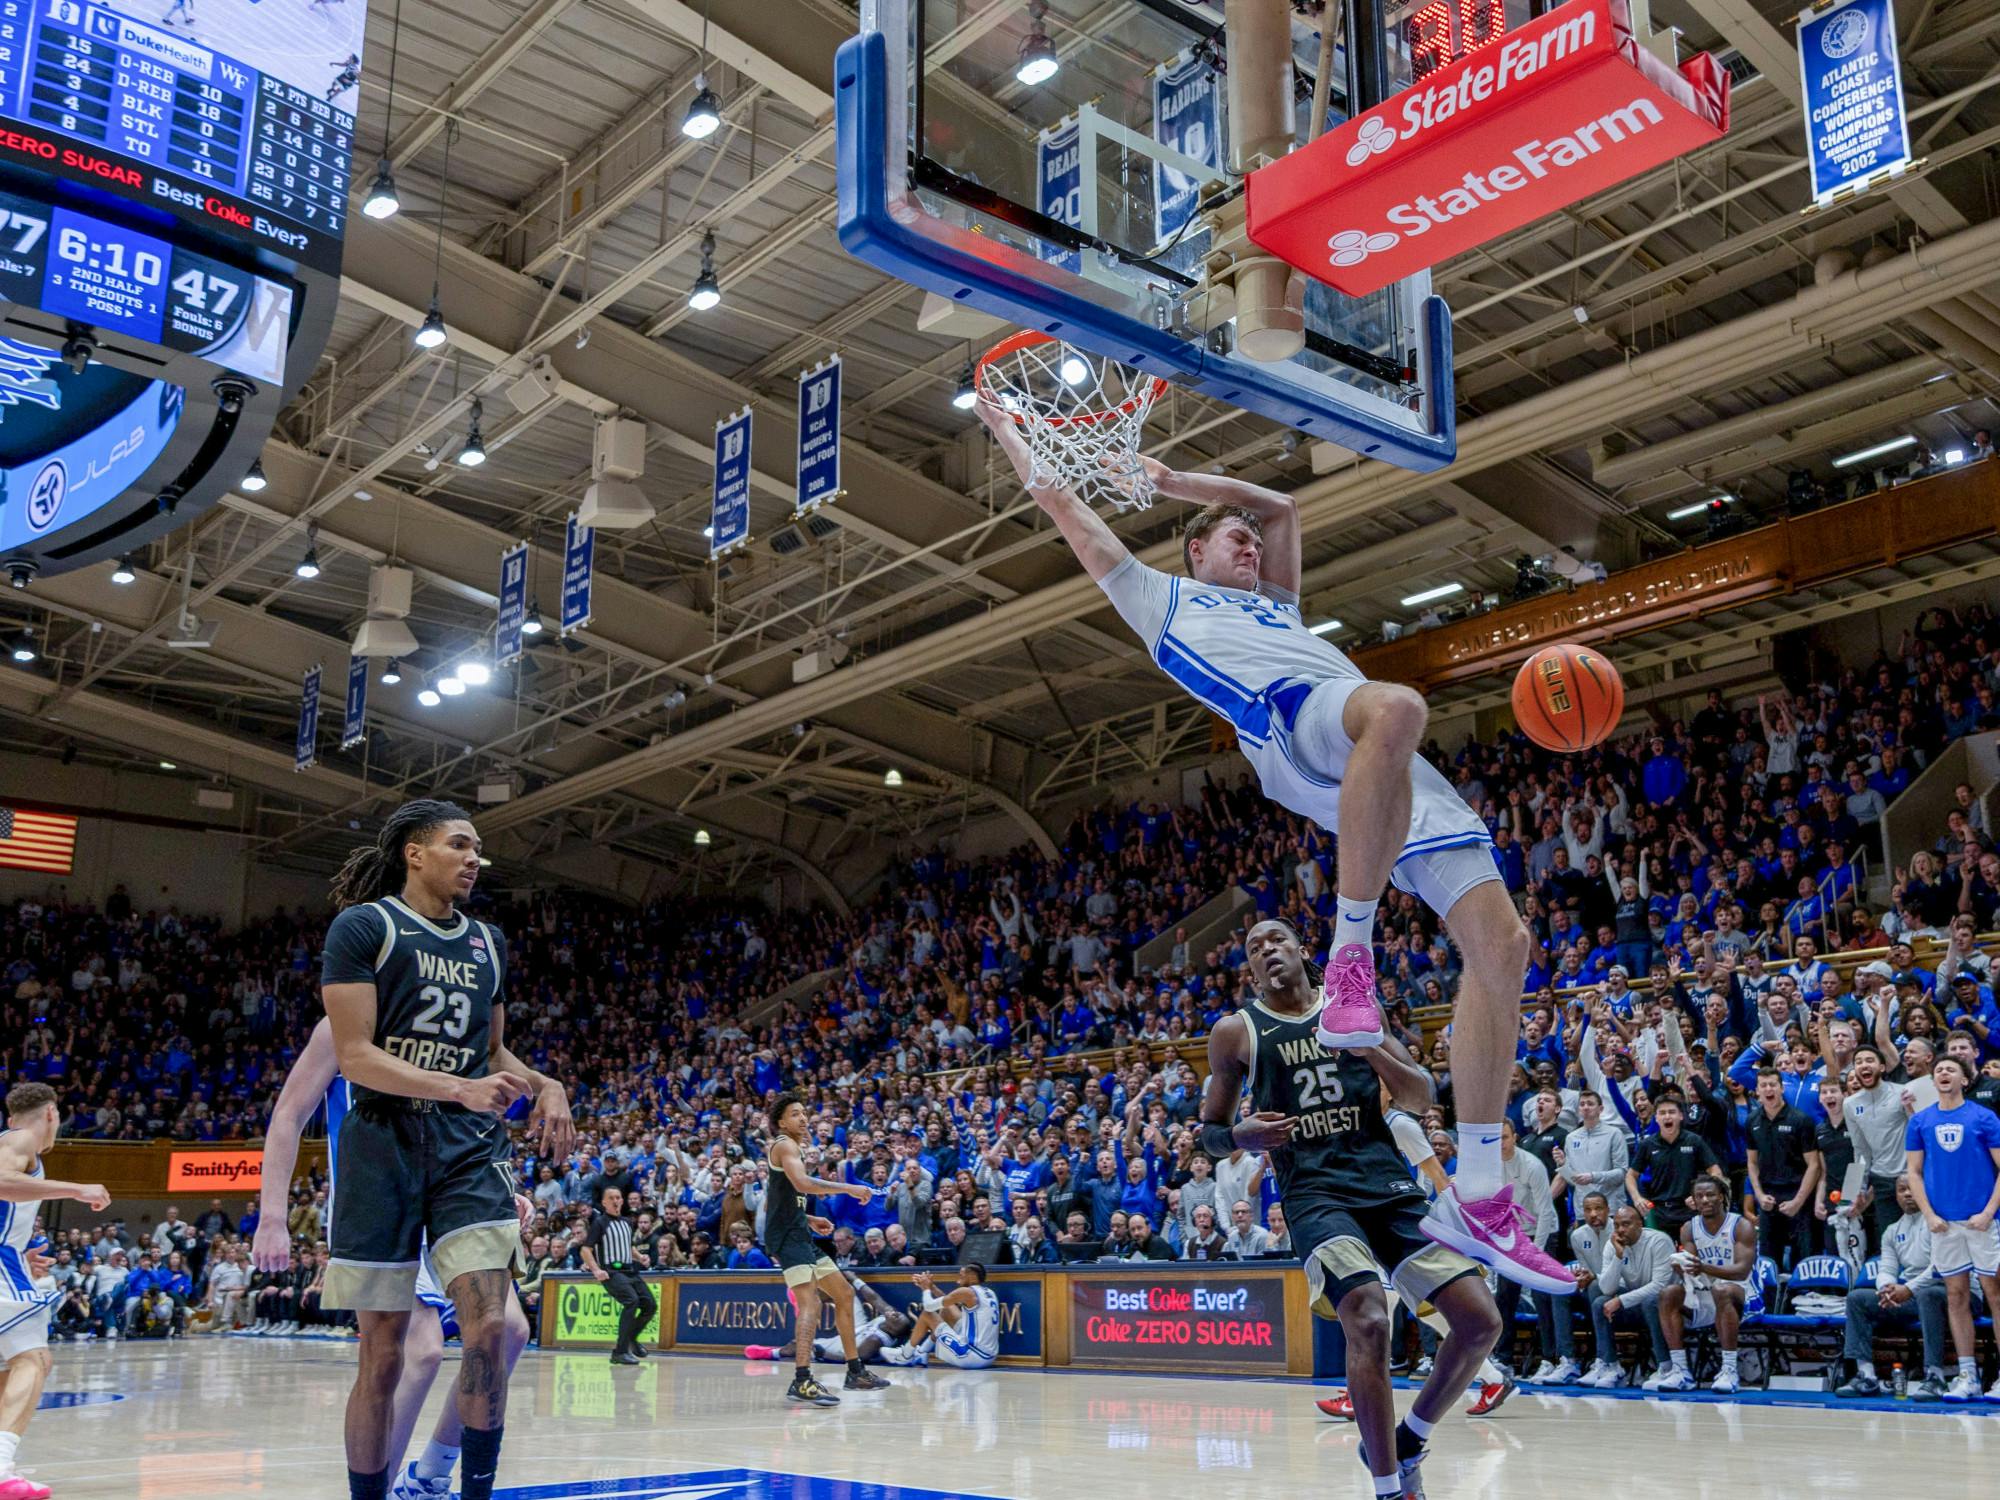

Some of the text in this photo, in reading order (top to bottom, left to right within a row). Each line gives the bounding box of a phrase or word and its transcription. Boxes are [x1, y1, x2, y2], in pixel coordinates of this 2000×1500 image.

[4, 2, 18, 17] 2
[1, 24, 14, 39] 2
[63, 53, 221, 121] 24 D-REB 18
[67, 35, 92, 54] 15
[199, 84, 222, 103] 10
[1821, 52, 1879, 89] ATLANTIC
[1831, 70, 1871, 98] COAST
[67, 74, 213, 137] 3 BLK 0
[262, 77, 353, 130] PL PTS REB FLS
[1813, 76, 1894, 123] CONFERENCE
[1824, 96, 1885, 133] WOMEN'S
[64, 95, 211, 157] 4 STL 1
[265, 101, 347, 148] 2 6 2 2
[1819, 108, 1894, 150] CHAMPIONS
[1858, 125, 1890, 143] SEASON
[62, 114, 213, 178] 8 TO 11
[262, 122, 274, 136] 4
[283, 130, 303, 149] 14
[333, 155, 345, 169] 4
[1832, 136, 1883, 164] TOURNAMENT
[1841, 150, 1878, 177] 2002
[261, 143, 343, 189] 6 0 3 2
[1047, 146, 1080, 183] BEAR
[62, 149, 143, 188] SUGAR
[153, 178, 204, 210] Best
[205, 197, 253, 229] Coke
[254, 216, 309, 250] Ever?
[254, 161, 275, 179] 23
[307, 184, 318, 198] 5
[330, 195, 341, 209] 2
[252, 182, 338, 230] 25 7 7 1
[0, 208, 48, 254] 7
[23, 265, 36, 277] 7
[59, 227, 162, 286] 6:10
[52, 274, 157, 314] 3 TIMEOUTS 1
[72, 266, 144, 295] 2ND HALF
[172, 268, 239, 316] 47
[86, 297, 123, 316] POSS
[173, 305, 213, 328] Fouls:
[172, 319, 214, 341] BONUS
[817, 445, 836, 462] FOUR
[1448, 554, 1752, 660] CAMERON INDOOR STADIUM
[415, 950, 479, 990] WAKE
[412, 985, 472, 1039] 23
[384, 1036, 475, 1073] FOREST
[1277, 1038, 1336, 1066] WAK
[1293, 1063, 1344, 1109] 25
[181, 1160, 262, 1181] Smithfiel
[1697, 1246, 1732, 1260] DUKE
[1797, 1259, 1845, 1281] DUKE
[687, 1300, 788, 1329] CAMERON
[1106, 1287, 1248, 1312] Best Coke Ever?
[1086, 1316, 1273, 1346] Coke ZERO SUGAR
